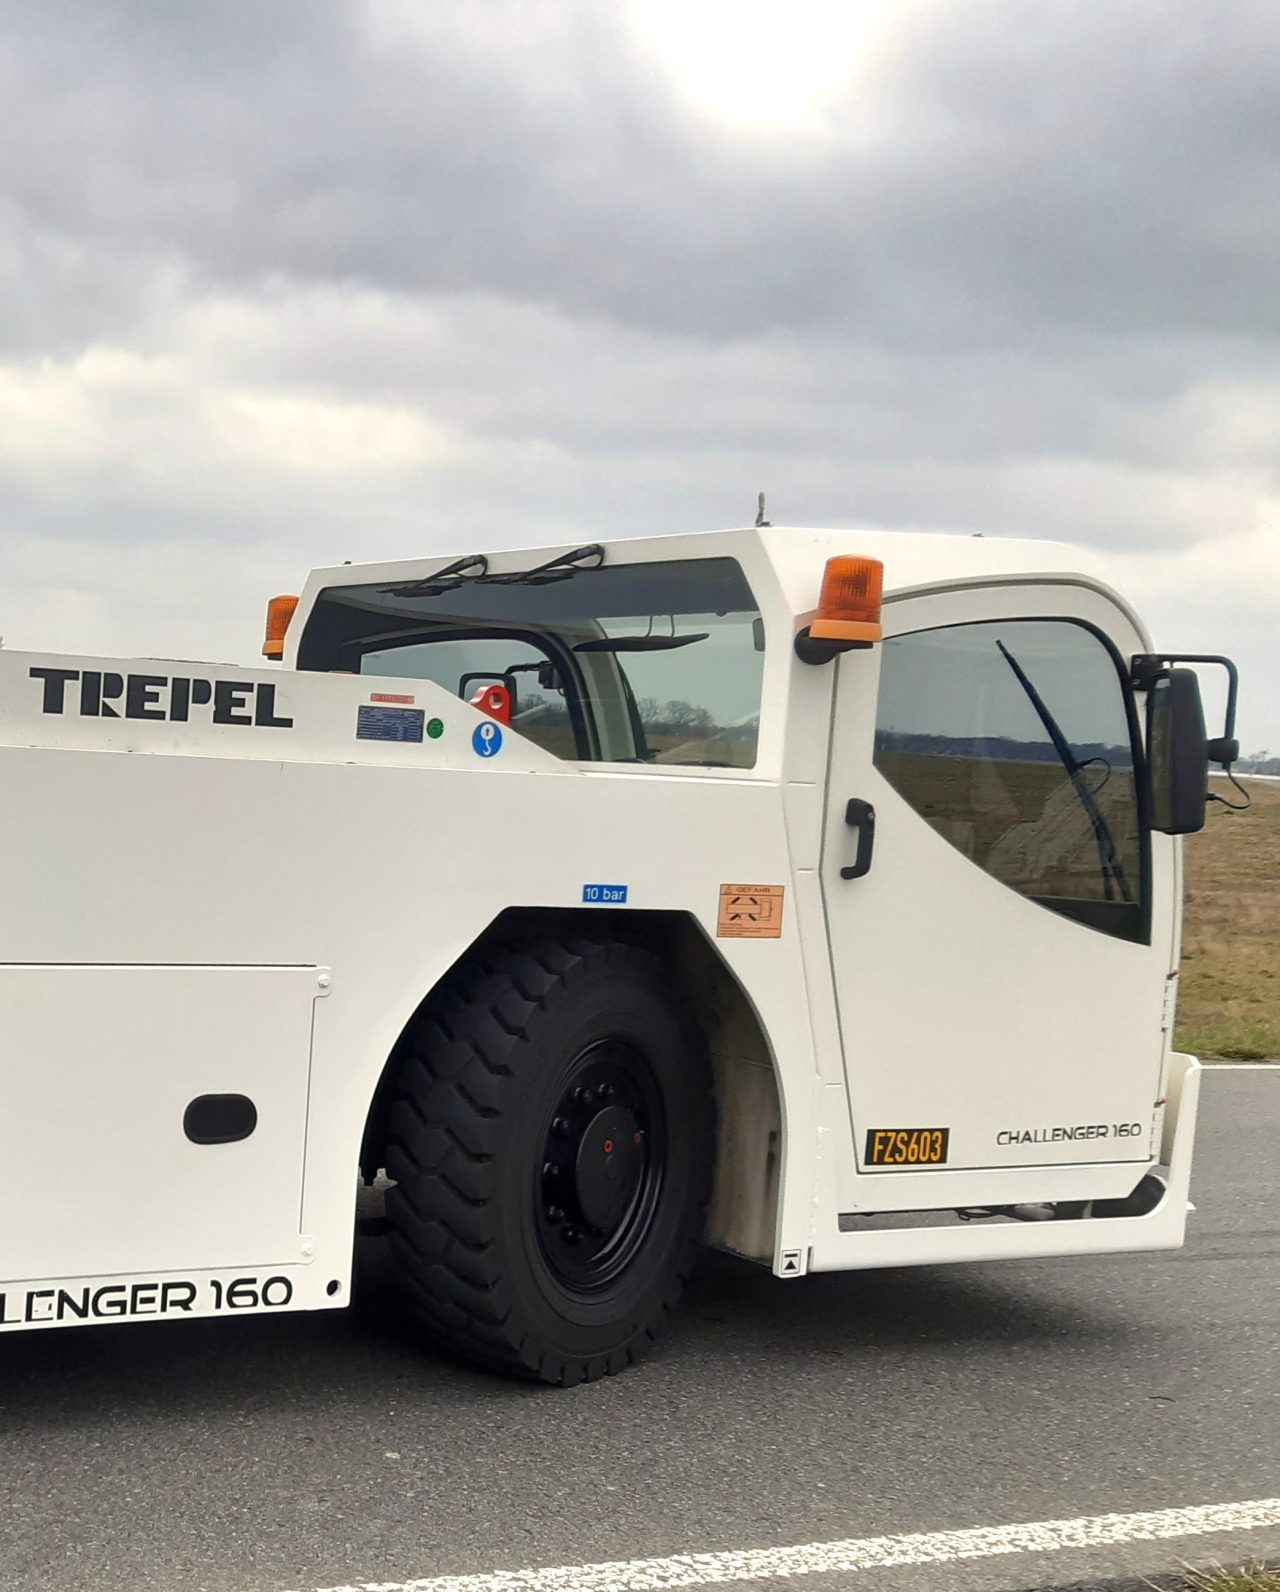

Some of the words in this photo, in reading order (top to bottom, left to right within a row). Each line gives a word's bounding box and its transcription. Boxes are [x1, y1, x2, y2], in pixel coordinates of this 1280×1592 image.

[29, 667, 293, 728] TREPEL
[585, 887, 599, 900] 10
[603, 888, 625, 900] bar
[736, 886, 771, 894] GEFAHR
[872, 1130, 943, 1164] FZS603
[996, 1124, 1108, 1146] CHALLENGER
[1112, 1122, 1142, 1137] 160
[210, 1275, 294, 1310] 160
